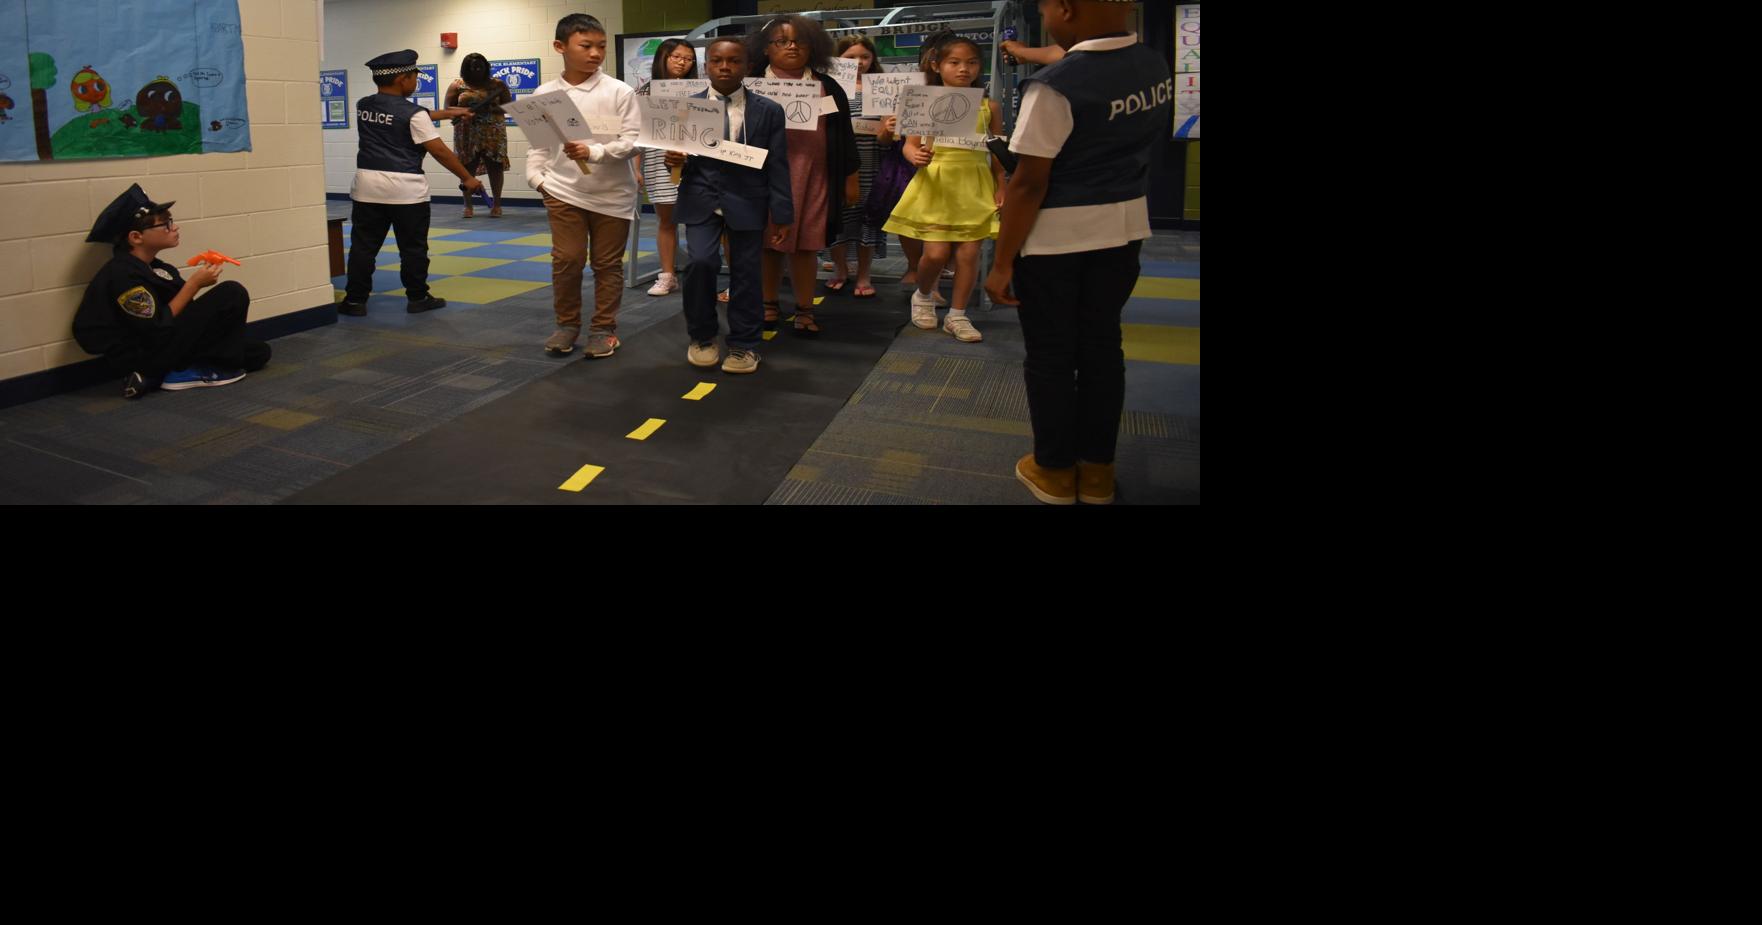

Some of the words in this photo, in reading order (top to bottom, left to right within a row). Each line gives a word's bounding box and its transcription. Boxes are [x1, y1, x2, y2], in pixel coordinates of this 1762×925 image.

[511, 66, 535, 79] PRIDE
[1108, 78, 1172, 121] POLICE
[357, 110, 394, 126] POLICE
